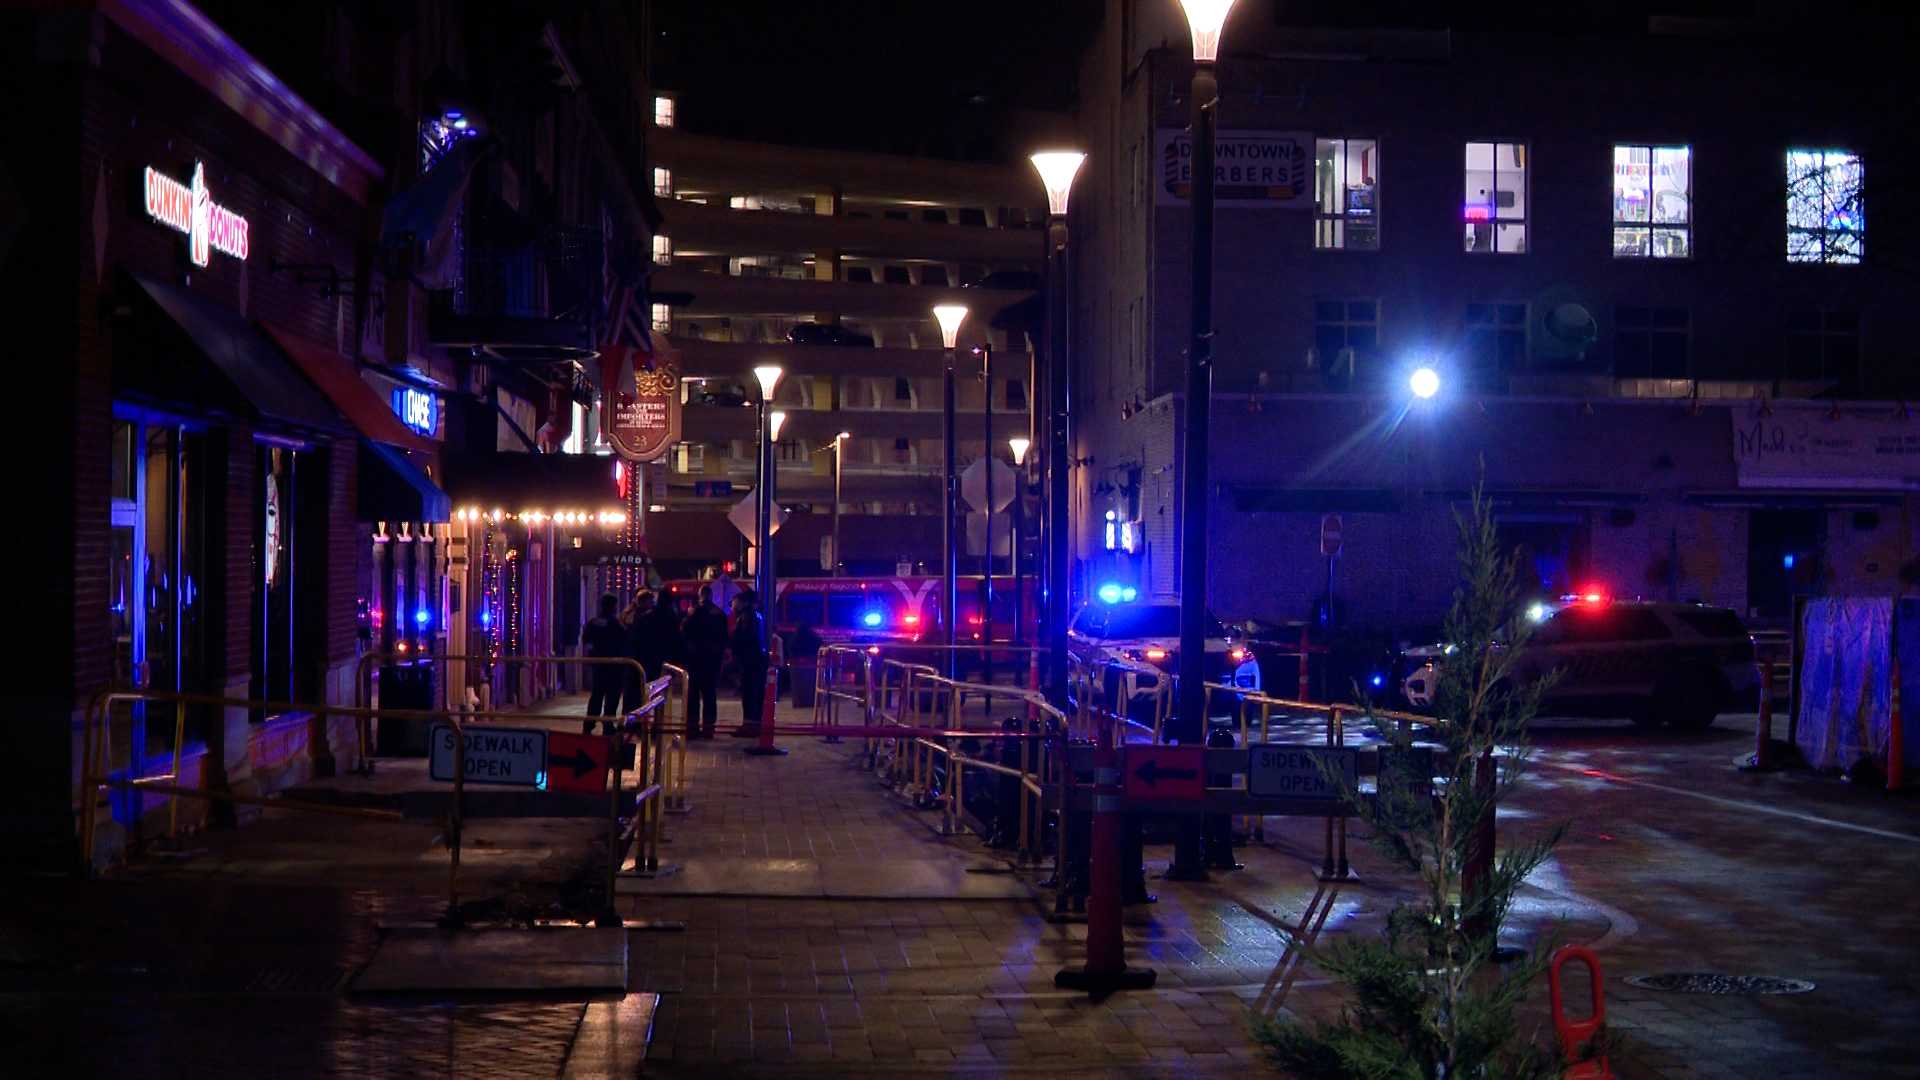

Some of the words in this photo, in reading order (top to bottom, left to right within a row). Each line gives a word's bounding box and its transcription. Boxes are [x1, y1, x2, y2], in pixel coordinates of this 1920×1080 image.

[1181, 143, 1289, 160] DWNTOWN
[1182, 166, 1289, 182] BRBERS
[208, 200, 248, 260] DONUTS
[445, 735, 533, 754] SDEWALK
[464, 759, 511, 777] OPEN
[1280, 776, 1324, 792] OPEN
